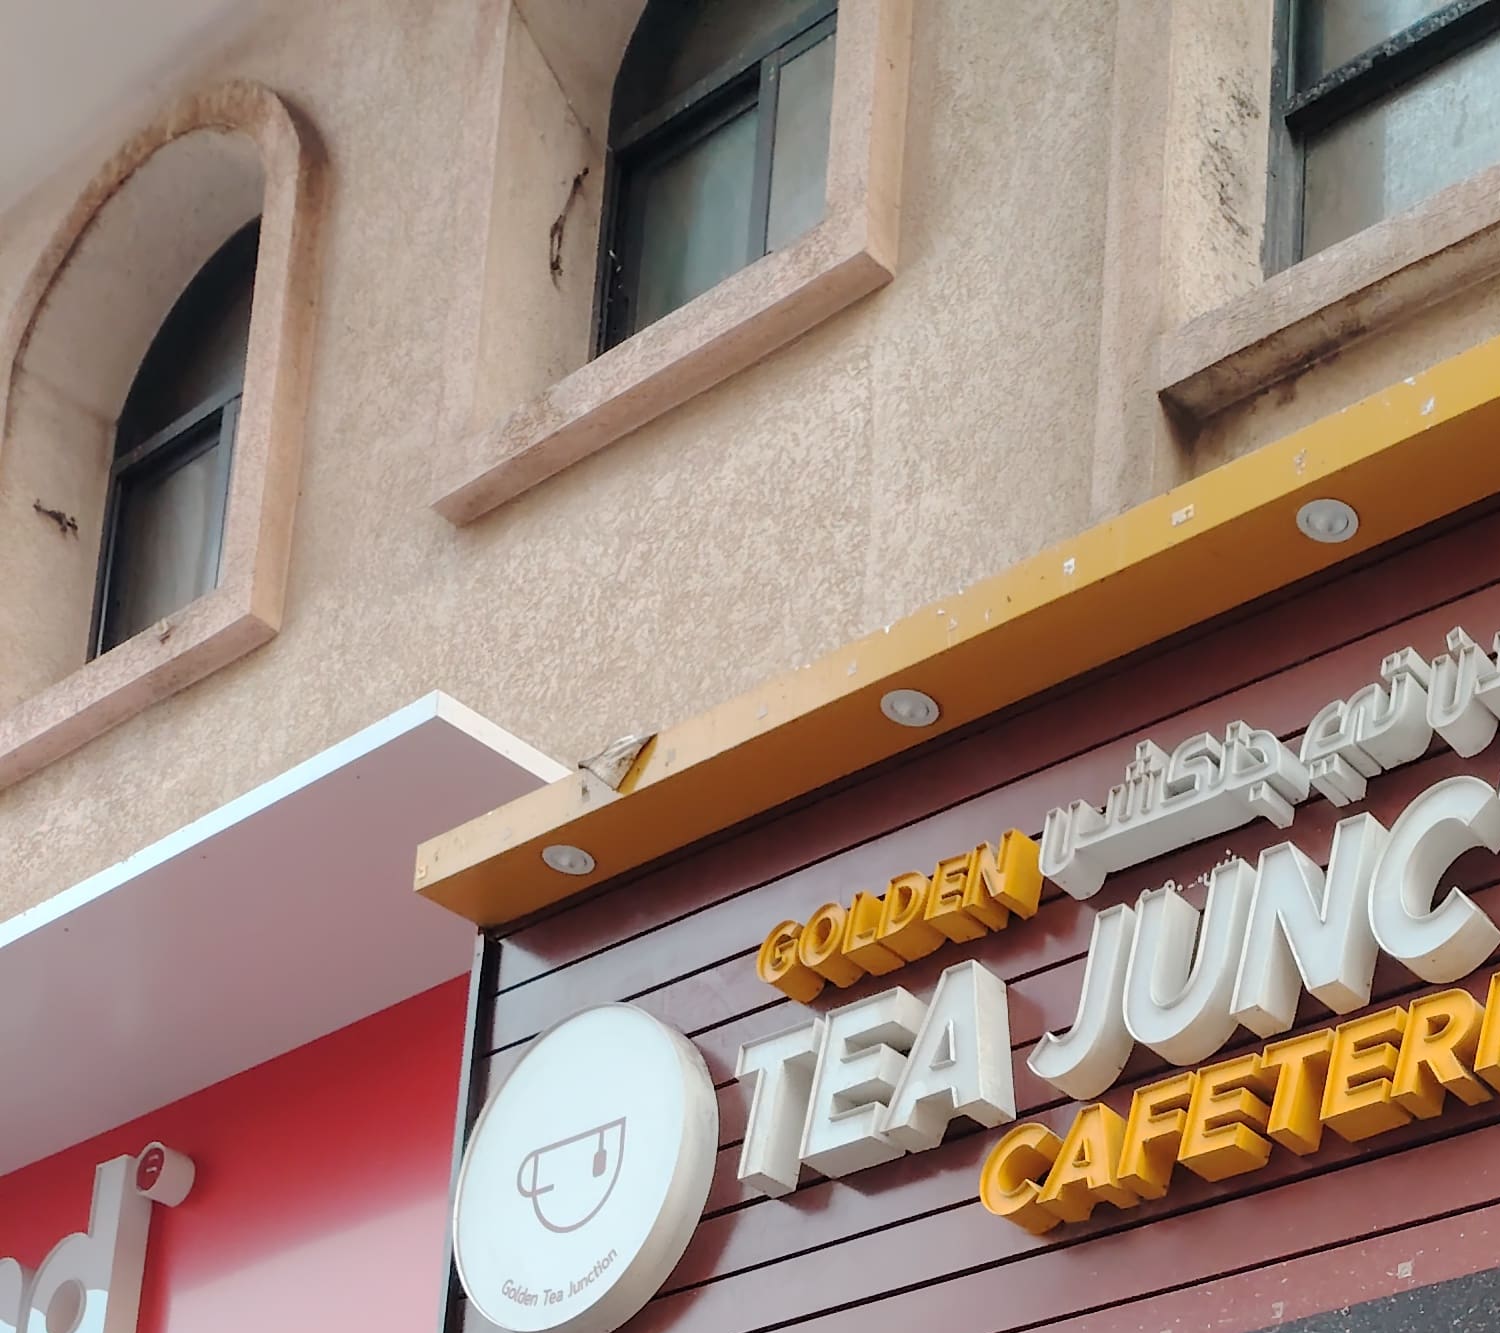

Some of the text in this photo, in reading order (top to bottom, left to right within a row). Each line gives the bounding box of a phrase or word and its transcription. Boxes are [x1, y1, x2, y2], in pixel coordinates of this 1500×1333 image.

[1300, 646, 1432, 808] تي
[754, 828, 1042, 1004] GOLDEN
[734, 958, 1016, 1200] TEA
[501, 1248, 618, 1307] Golden Tea Junction
